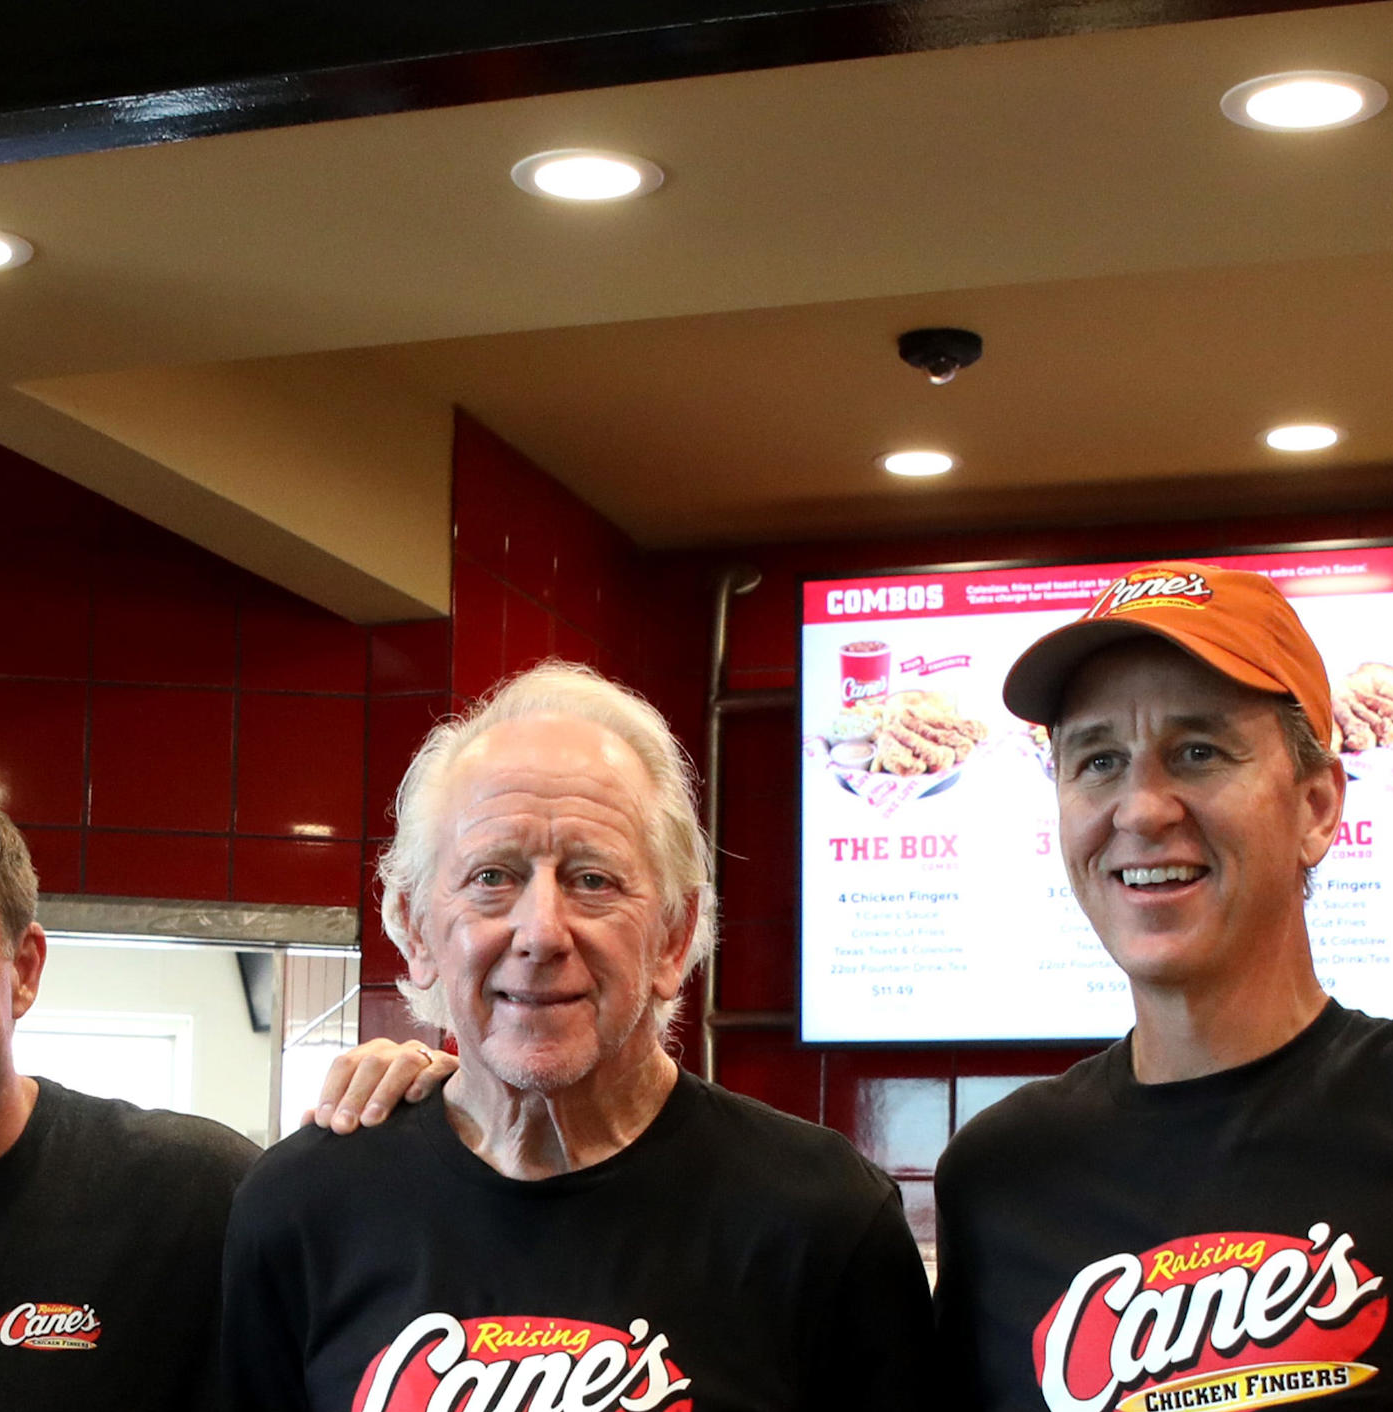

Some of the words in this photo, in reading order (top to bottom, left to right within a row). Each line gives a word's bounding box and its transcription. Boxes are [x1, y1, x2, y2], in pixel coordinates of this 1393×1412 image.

[826, 584, 944, 615] COMBOS
[829, 837, 889, 861] THE
[900, 834, 959, 859] BOX
[838, 892, 847, 903] 4
[851, 892, 905, 904] Chicken
[909, 890, 959, 904] Fingers
[1327, 879, 1382, 893] Fingers
[1147, 1237, 1267, 1283] Raising
[0, 1302, 101, 1346] Cane's
[471, 1322, 591, 1355] Raising
[1245, 1366, 1348, 1397] FINGERS
